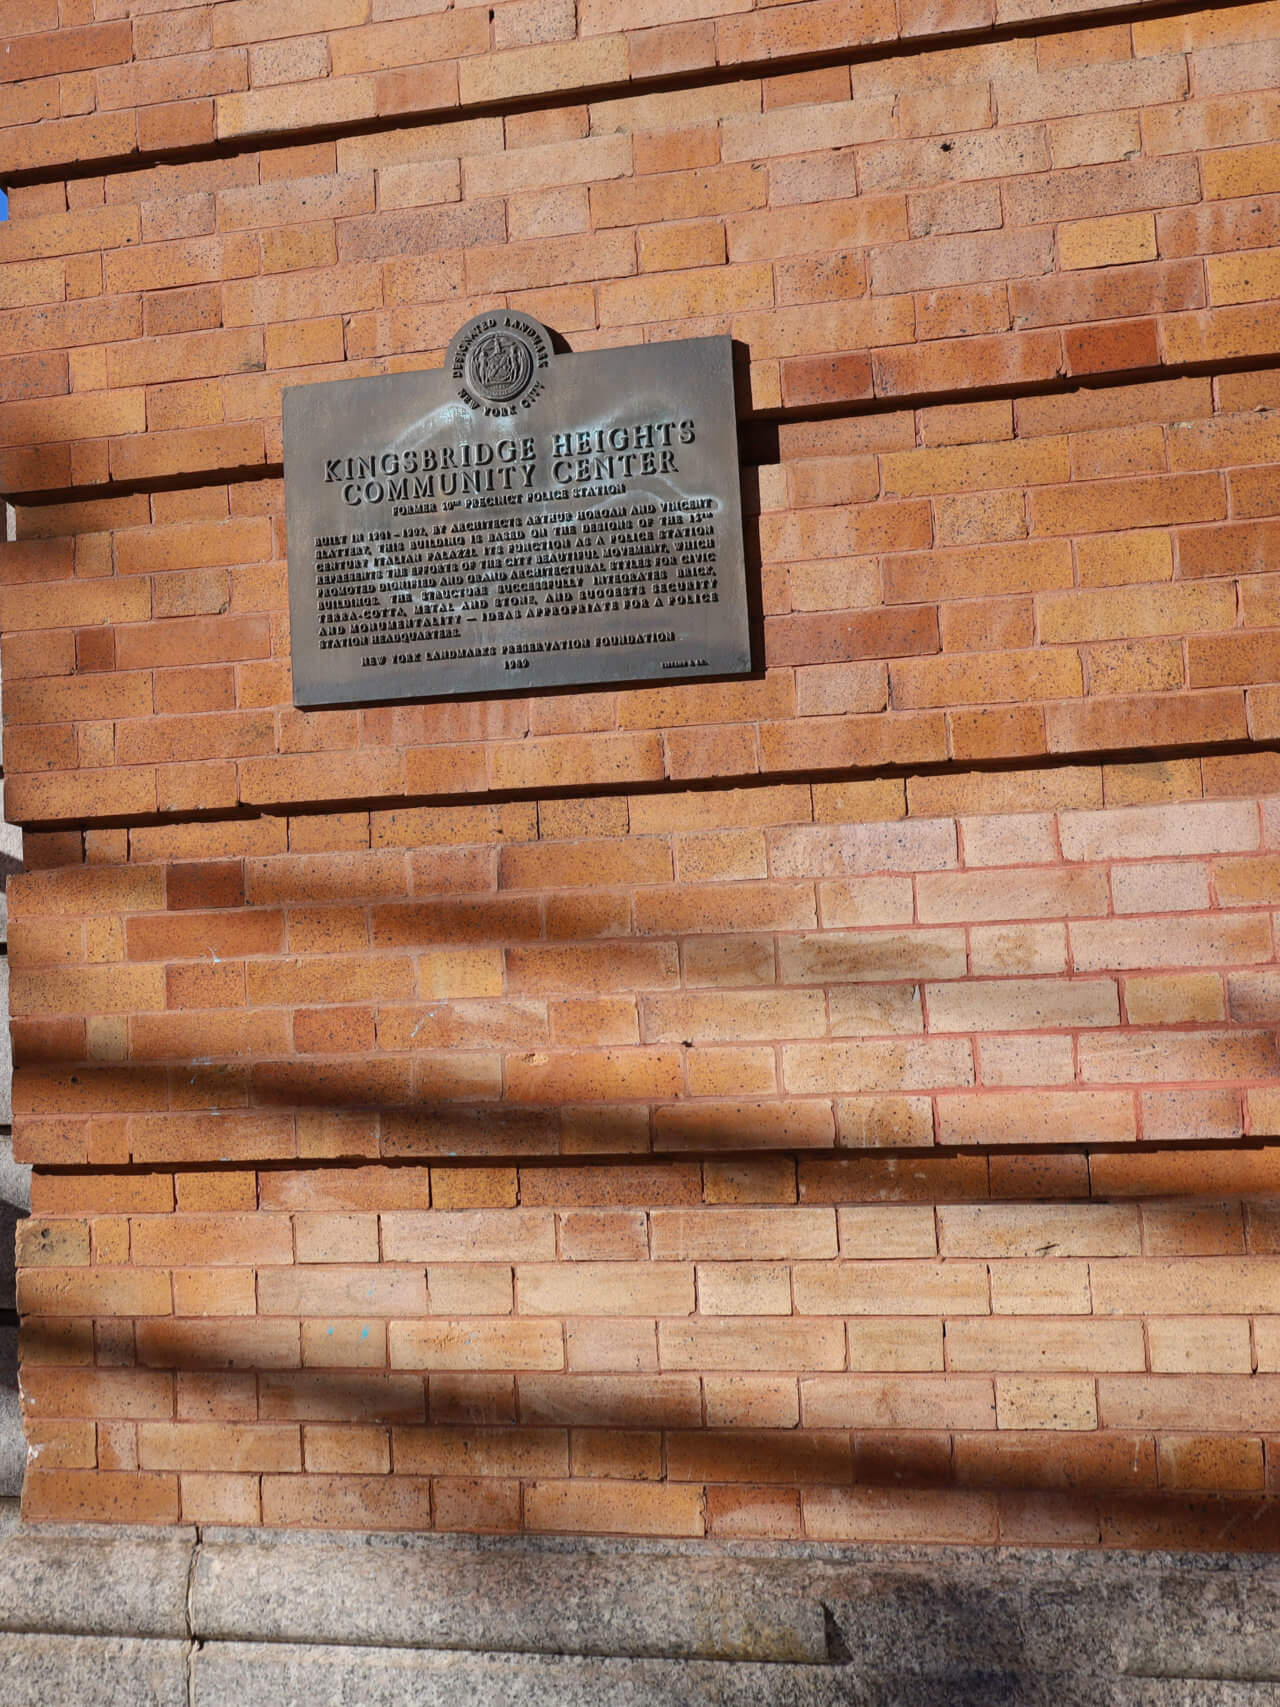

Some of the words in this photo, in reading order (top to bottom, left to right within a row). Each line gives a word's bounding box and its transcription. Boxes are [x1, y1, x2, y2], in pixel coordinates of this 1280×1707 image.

[452, 319, 497, 379] DESIGNATED
[504, 317, 550, 369] LANDMARK
[457, 388, 481, 410] NEW
[483, 404, 518, 417] YORK
[520, 380, 545, 409] CITY
[323, 437, 536, 482] KINGSBRIDGE
[552, 420, 696, 458] HEIGHTS
[344, 464, 538, 506] COMMUNITY
[553, 449, 680, 485] CENTER
[393, 503, 437, 516] FORMER
[466, 495, 523, 509] PRECINCT
[527, 490, 569, 503] POLICE
[573, 484, 626, 498] STATION
[315, 535, 347, 547] BUILT
[351, 533, 363, 543] IN
[433, 525, 446, 535] BY
[451, 518, 522, 534] ARCHITECTS
[527, 513, 573, 526] ARTHUR
[631, 505, 657, 516] AND
[661, 499, 713, 513] VINCENT
[378, 543, 404, 554] THIS
[411, 537, 465, 551] BUILDING
[471, 536, 483, 545] IS
[488, 531, 525, 543] BASED
[531, 529, 548, 539] ON
[554, 527, 576, 537] THE
[582, 521, 633, 535] DESIGNS
[639, 519, 654, 529] OF
[660, 516, 683, 527] THE
[316, 559, 368, 572] CENTURY
[374, 554, 422, 567] ITALIAN
[484, 546, 503, 556] ITS
[508, 540, 570, 554] FUNCTION
[576, 538, 591, 548] AS
[611, 532, 654, 545] POLICE
[659, 527, 714, 540] STATION
[317, 571, 383, 585] REPRESENTS
[387, 568, 408, 578] THE
[412, 564, 458, 576] EFFORTS
[463, 562, 476, 571] OF
[480, 560, 502, 570] THE
[505, 557, 532, 568] CITY
[536, 551, 599, 565] BEAUTIFUL
[673, 540, 715, 552] WHICH
[318, 584, 376, 598] PROMOTED
[380, 579, 436, 592] DIGNIFIED
[440, 576, 464, 587] AND
[468, 572, 507, 584] GRAND
[511, 563, 606, 580] ARCHITECTURAL
[610, 559, 652, 571] STYLES
[656, 557, 677, 567] FOR
[680, 553, 716, 565] CIVIC
[391, 594, 413, 604] THE
[422, 587, 489, 601] STRUCTURE
[498, 578, 584, 594] SUCCESSFULLY
[593, 571, 667, 586] INTEGRATES
[319, 626, 346, 636] AND
[351, 616, 461, 633] MONUMENTALITY
[482, 611, 522, 622] IDEAS
[526, 602, 619, 618] APPROPRIATE
[624, 600, 649, 610] FOR
[669, 594, 719, 606] POLICE
[414, 603, 454, 615] METAL
[462, 600, 489, 611] AND
[545, 593, 573, 604] AND
[579, 586, 646, 601] SUGGESTS
[652, 580, 718, 595] SECURITY
[320, 637, 368, 650] STATION
[362, 656, 387, 666] NEW
[393, 653, 421, 664] YORK
[426, 647, 496, 661] LANDMARKS
[502, 639, 591, 655] PRESERVATION
[595, 632, 675, 647] FOUNDATION
